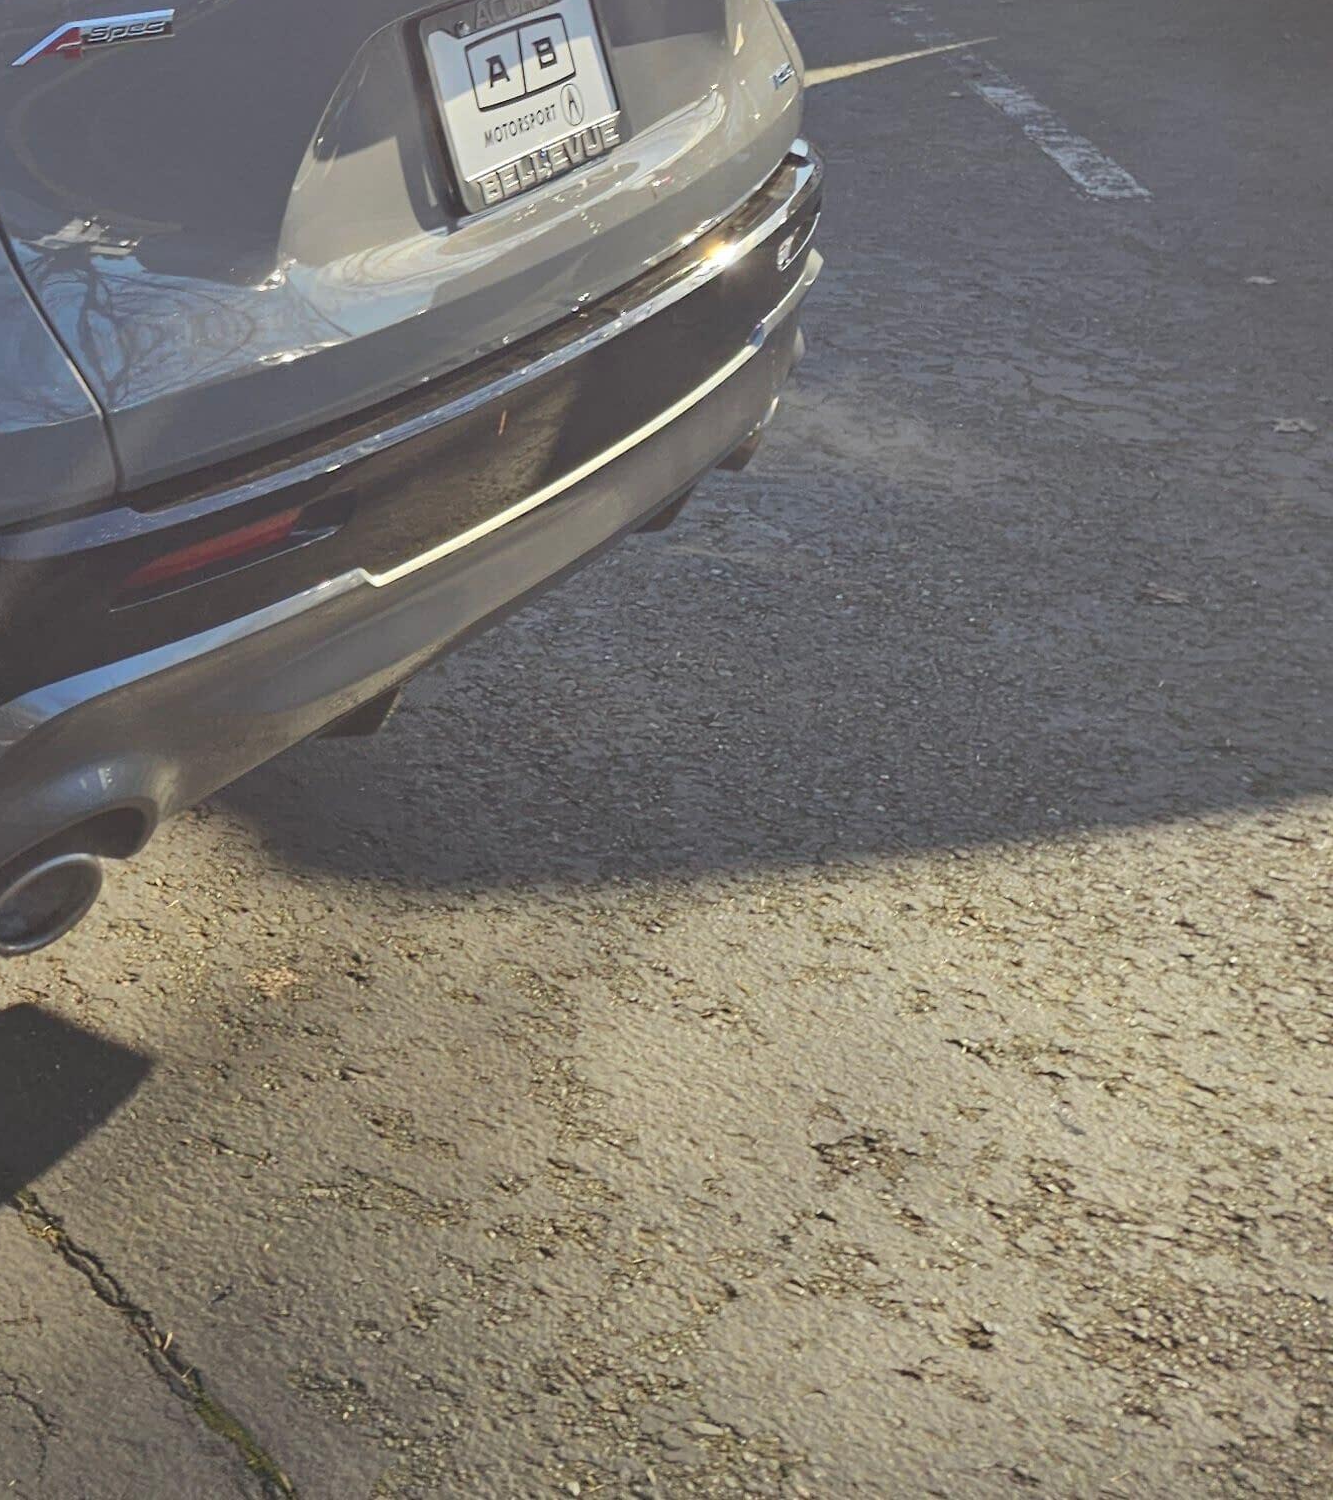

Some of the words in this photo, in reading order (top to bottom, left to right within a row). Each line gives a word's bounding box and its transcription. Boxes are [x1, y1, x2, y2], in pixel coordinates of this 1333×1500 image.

[485, 54, 511, 89] A
[531, 36, 558, 71] B
[483, 104, 558, 149] MOTORSPORT
[476, 114, 623, 206] BELLEVUE
